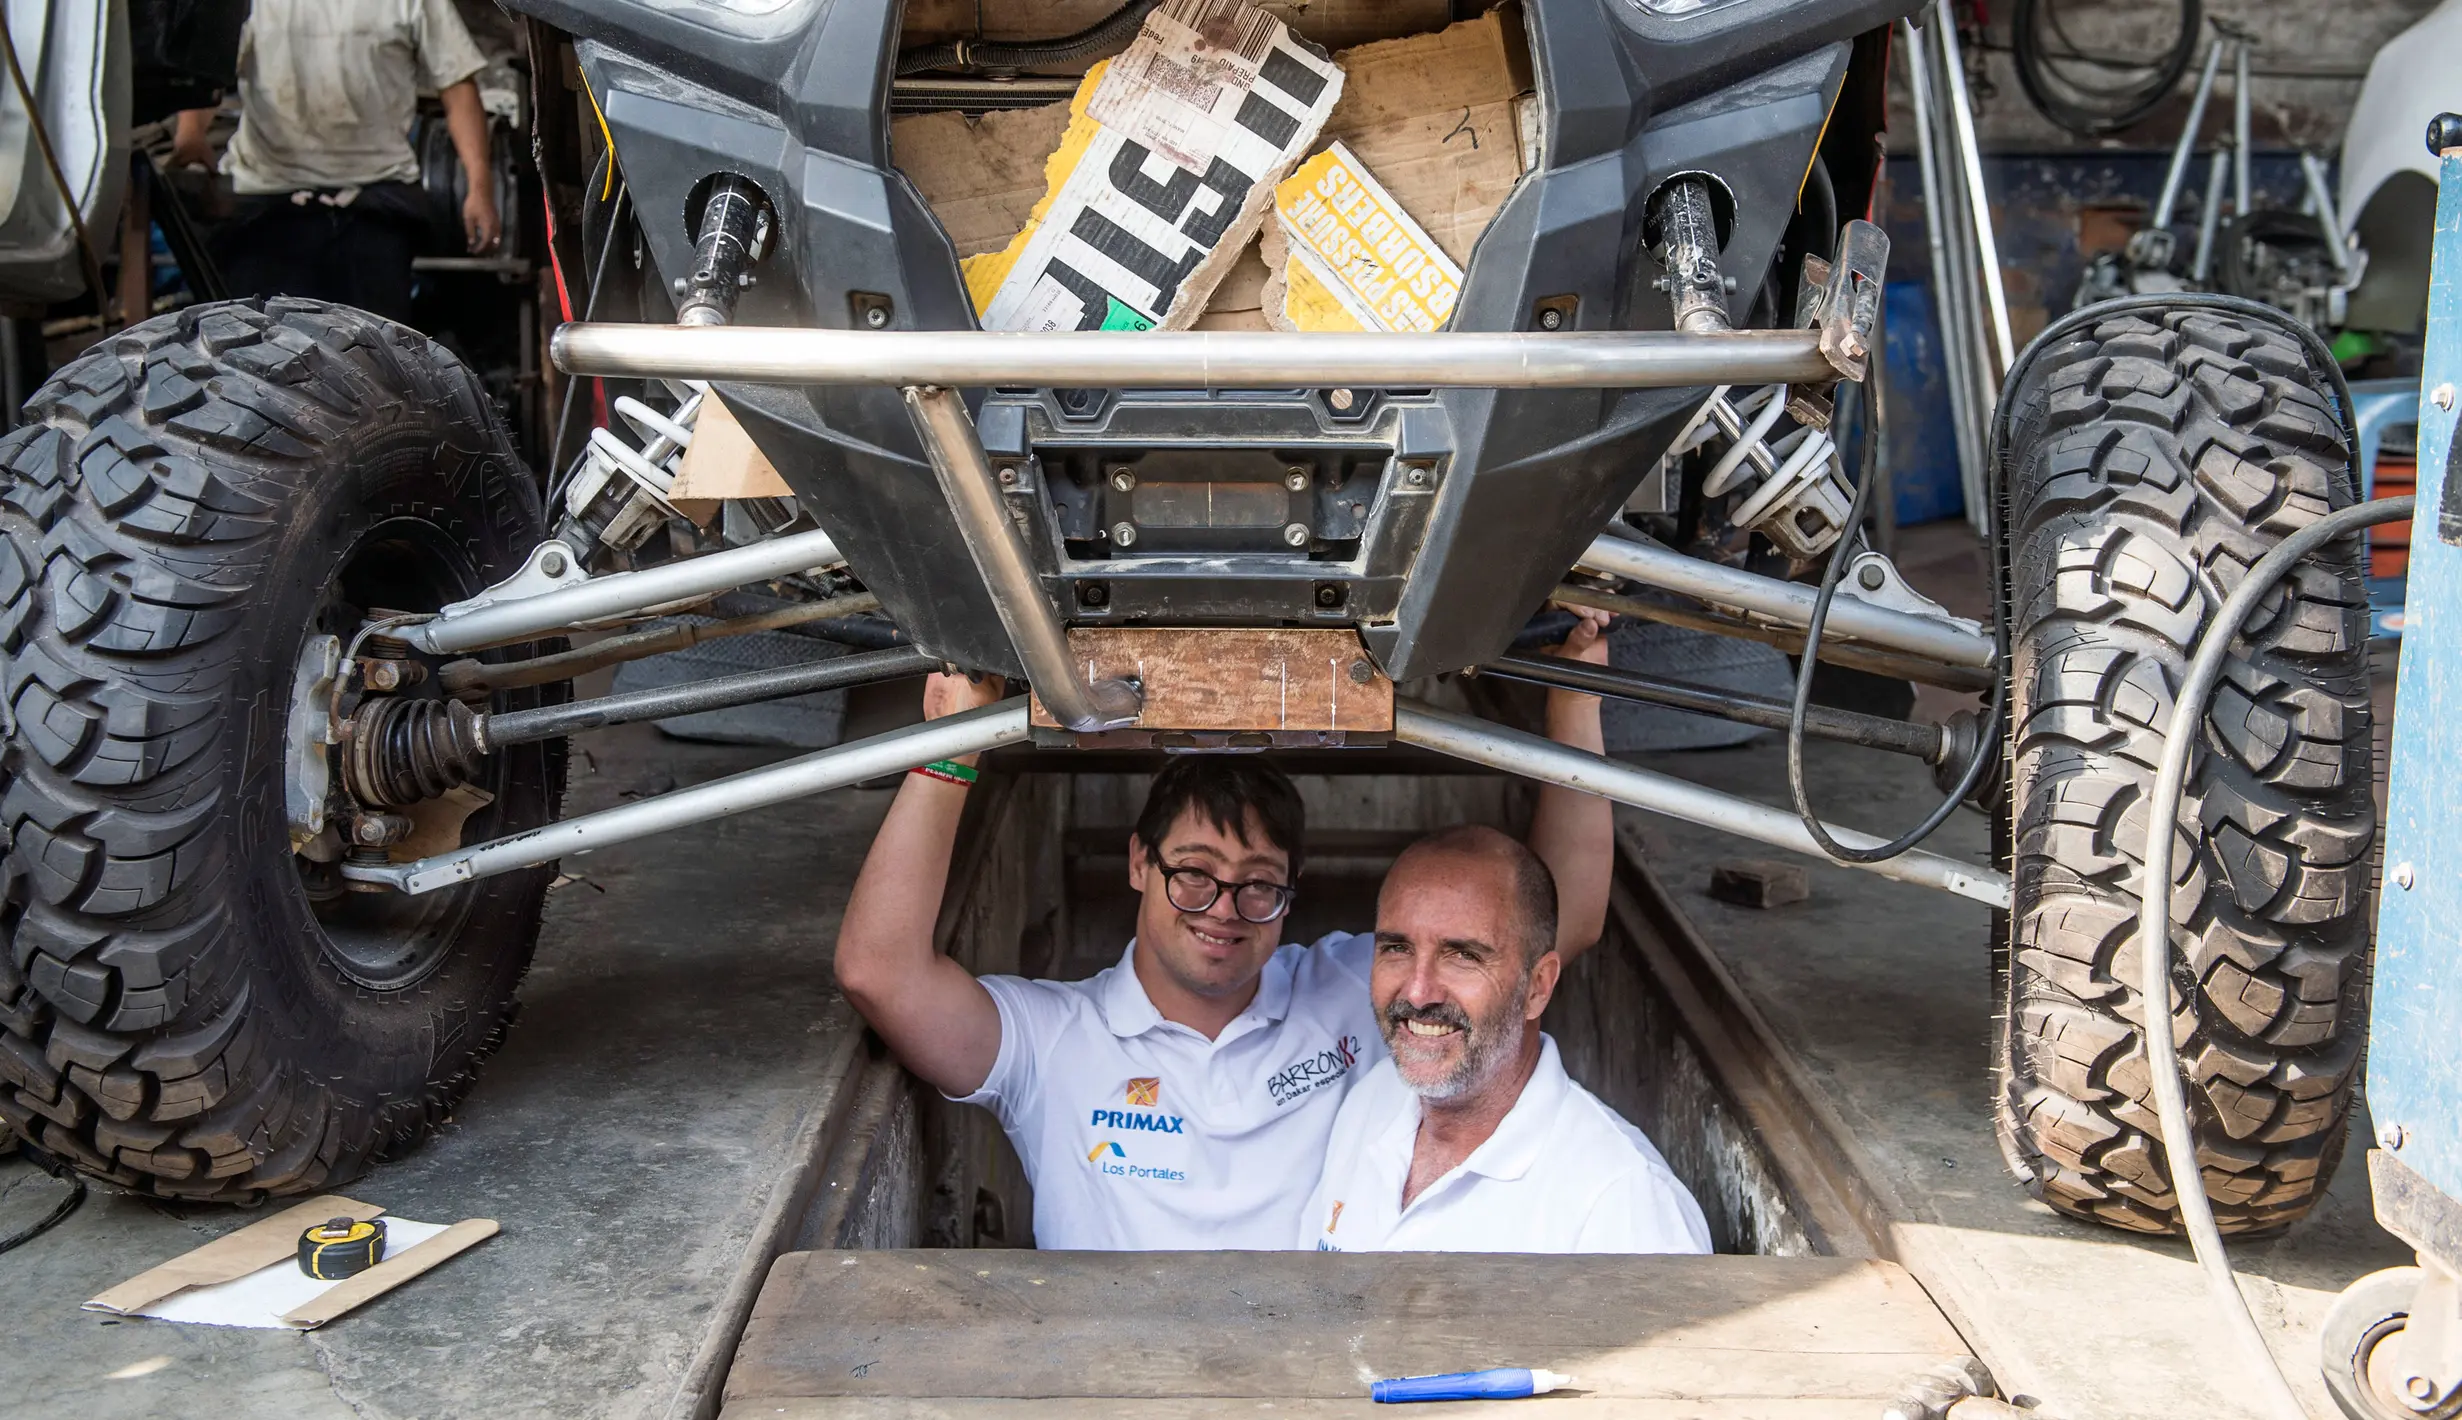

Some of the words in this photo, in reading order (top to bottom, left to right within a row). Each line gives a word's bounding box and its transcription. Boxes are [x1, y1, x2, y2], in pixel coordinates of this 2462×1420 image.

[1219, 57, 1257, 84] PREPAID
[1231, 76, 1252, 92] GND
[1286, 190, 1397, 305] PRESSURE
[1285, 1084, 1312, 1101] Dakar
[1091, 1109, 1184, 1134] PRIMAX
[1102, 1160, 1125, 1176] Los
[1129, 1165, 1185, 1180] Portales
